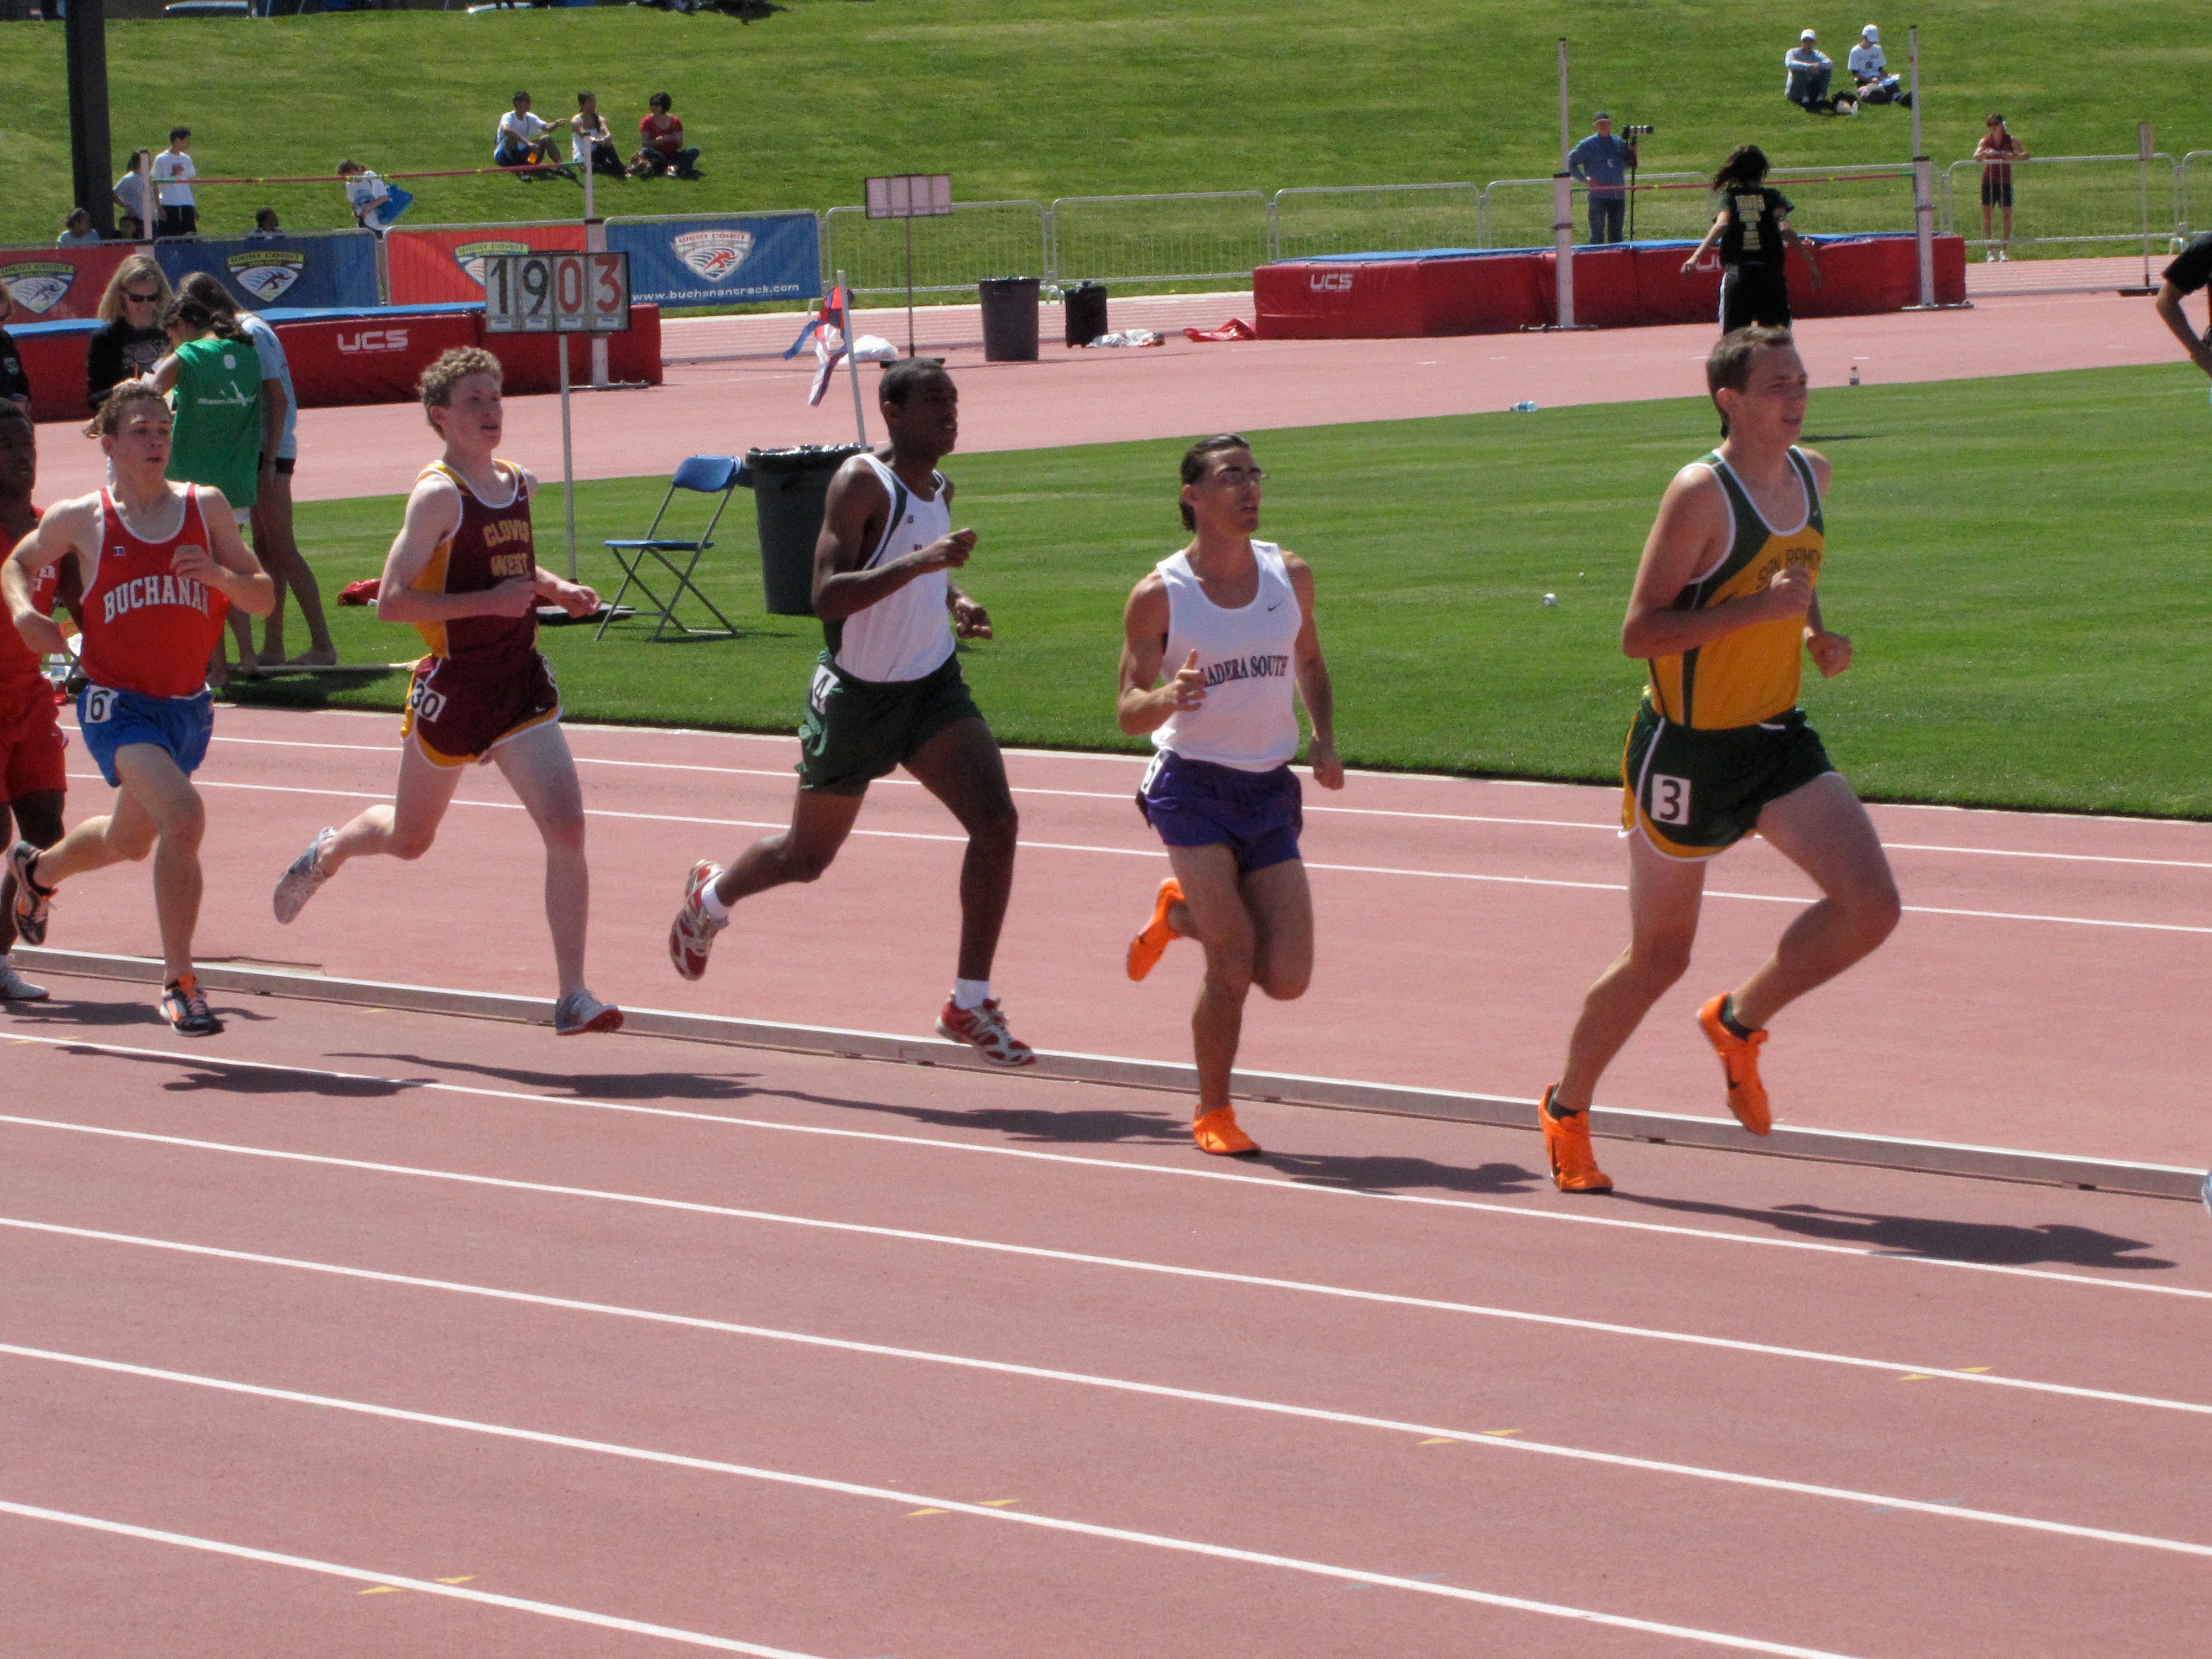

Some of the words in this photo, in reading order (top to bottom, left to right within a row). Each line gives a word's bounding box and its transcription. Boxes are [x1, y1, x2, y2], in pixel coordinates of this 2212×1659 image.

[491, 255, 622, 314] 1903
[632, 283, 800, 302] www.buchanantrack.com
[1310, 273, 1353, 290] UCS
[337, 329, 409, 352] UCS
[483, 519, 530, 547] CLOVIS
[1201, 659, 1249, 687] ADERA
[90, 689, 110, 721] 6
[411, 682, 440, 718] 30
[1660, 779, 1681, 821] 3
